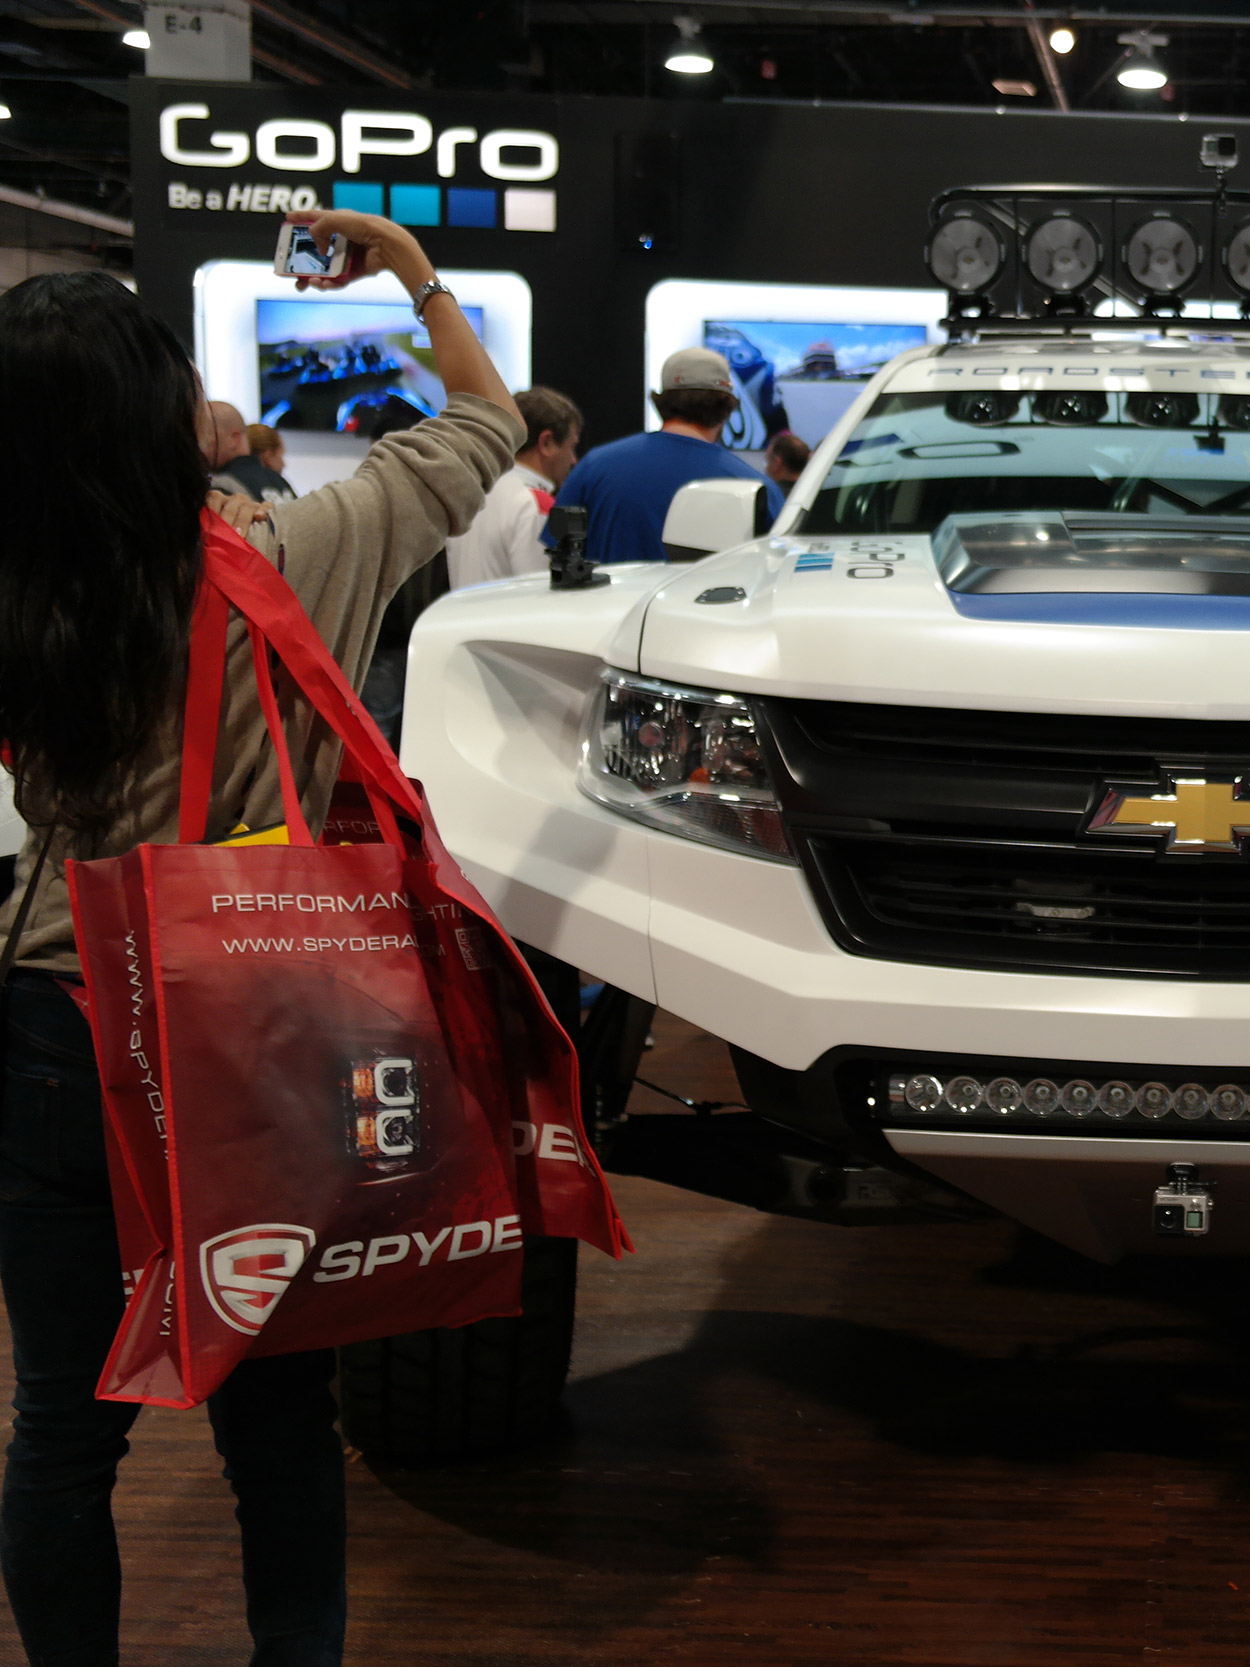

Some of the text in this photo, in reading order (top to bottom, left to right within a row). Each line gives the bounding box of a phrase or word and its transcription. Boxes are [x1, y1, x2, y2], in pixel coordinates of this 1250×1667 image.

[165, 14, 202, 34] E-4
[160, 103, 559, 182] GoPro
[168, 181, 202, 209] Be
[205, 190, 224, 211] a
[222, 934, 419, 954] WWW.SPYDERA
